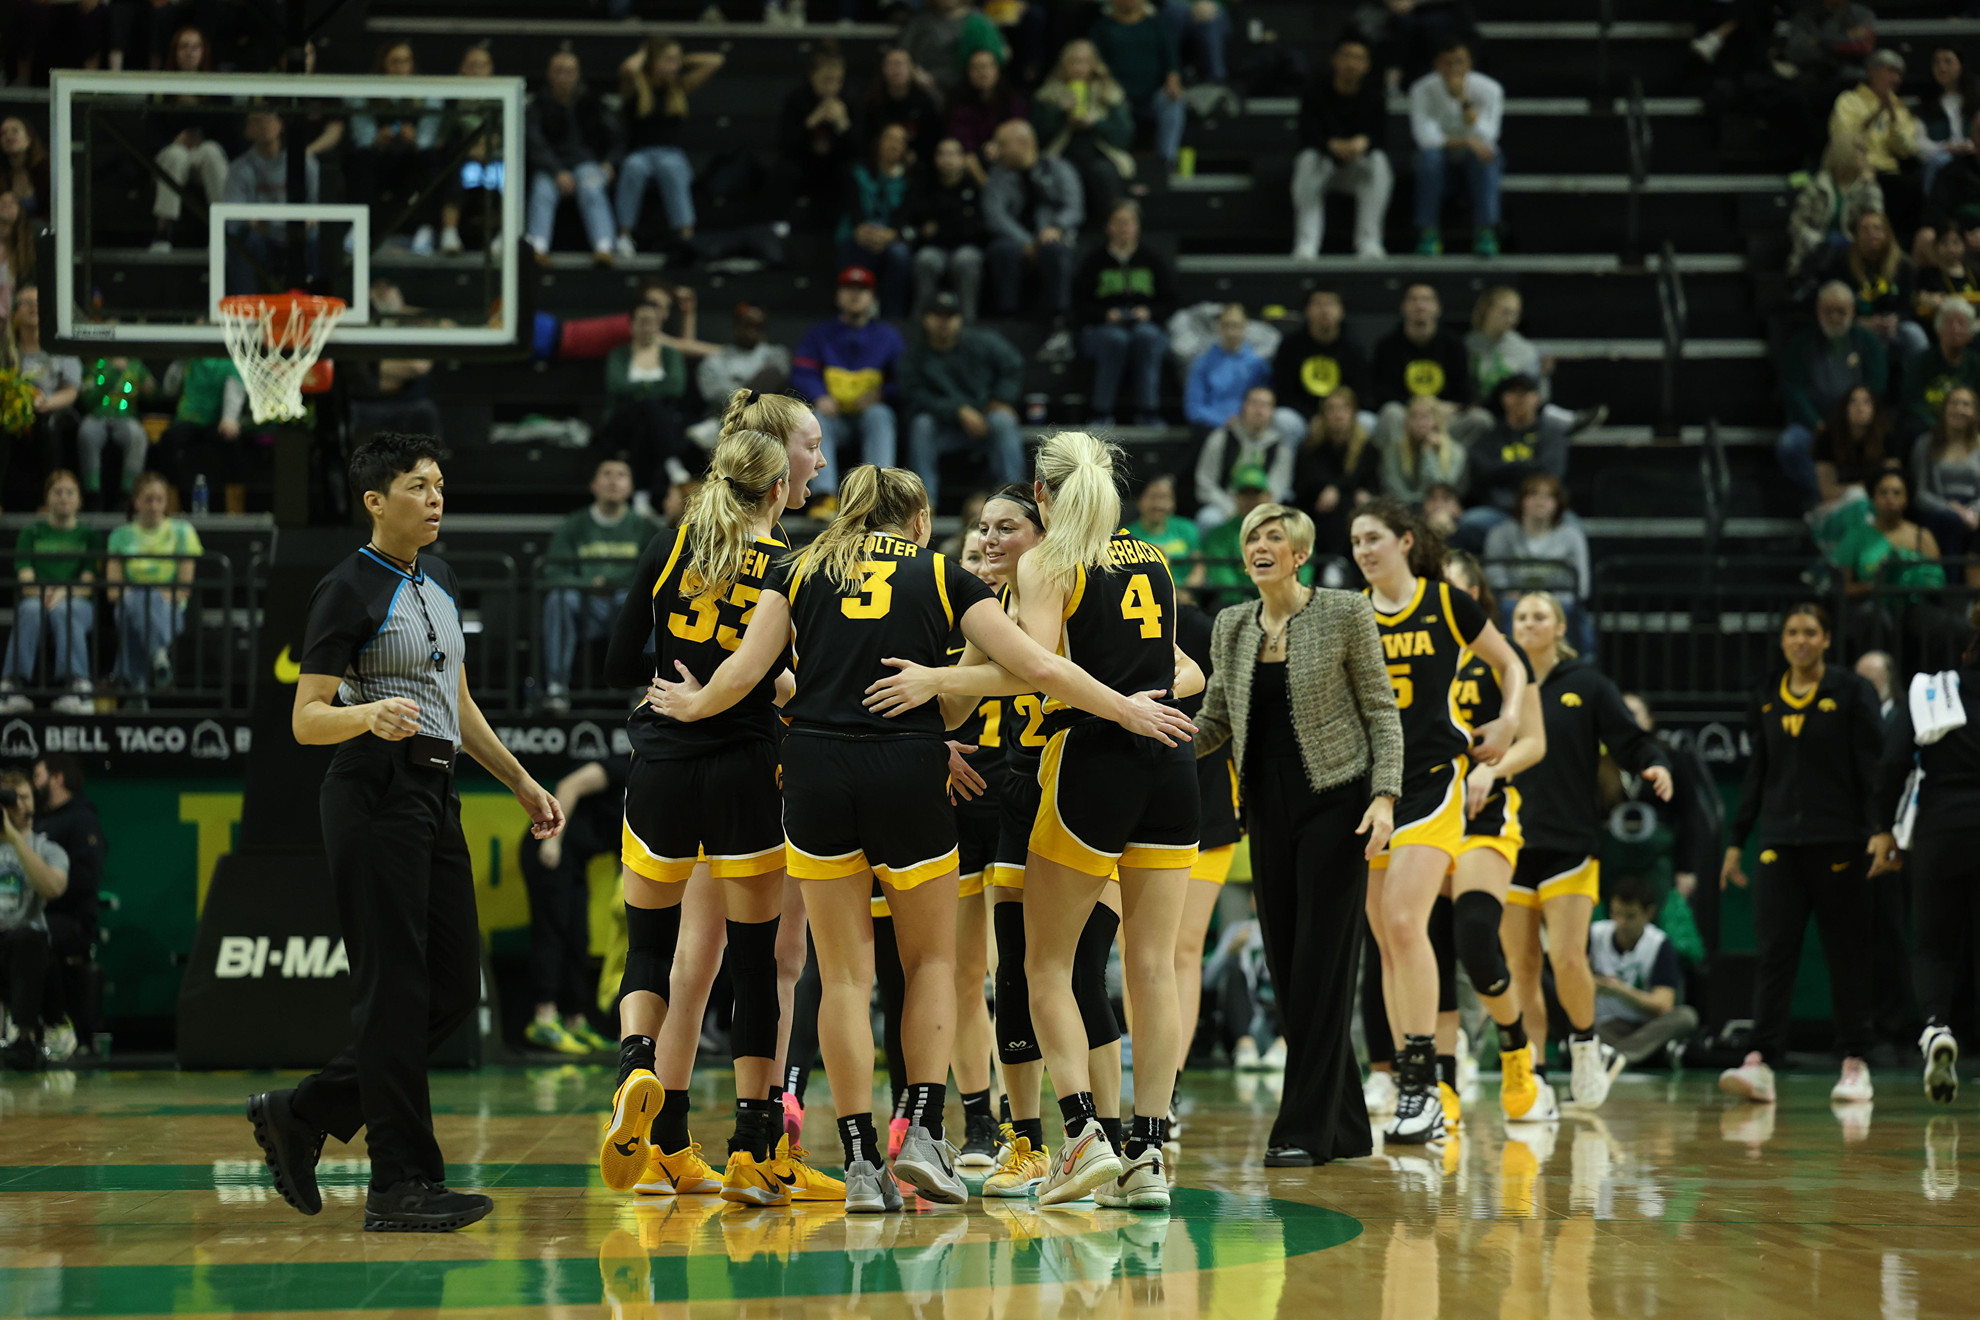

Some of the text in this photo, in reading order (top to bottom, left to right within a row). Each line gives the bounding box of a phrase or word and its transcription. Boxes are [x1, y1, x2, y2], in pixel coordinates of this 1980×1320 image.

[741, 547, 770, 580] EN
[859, 536, 918, 558] OLTER
[667, 568, 762, 652] 33
[841, 560, 897, 620] 3
[1120, 573, 1162, 639] 4
[1385, 663, 1414, 709] 5
[45, 726, 187, 753] BELL TACO
[496, 727, 566, 754] TACO
[978, 699, 1001, 748] 1
[1013, 694, 1048, 747] 2
